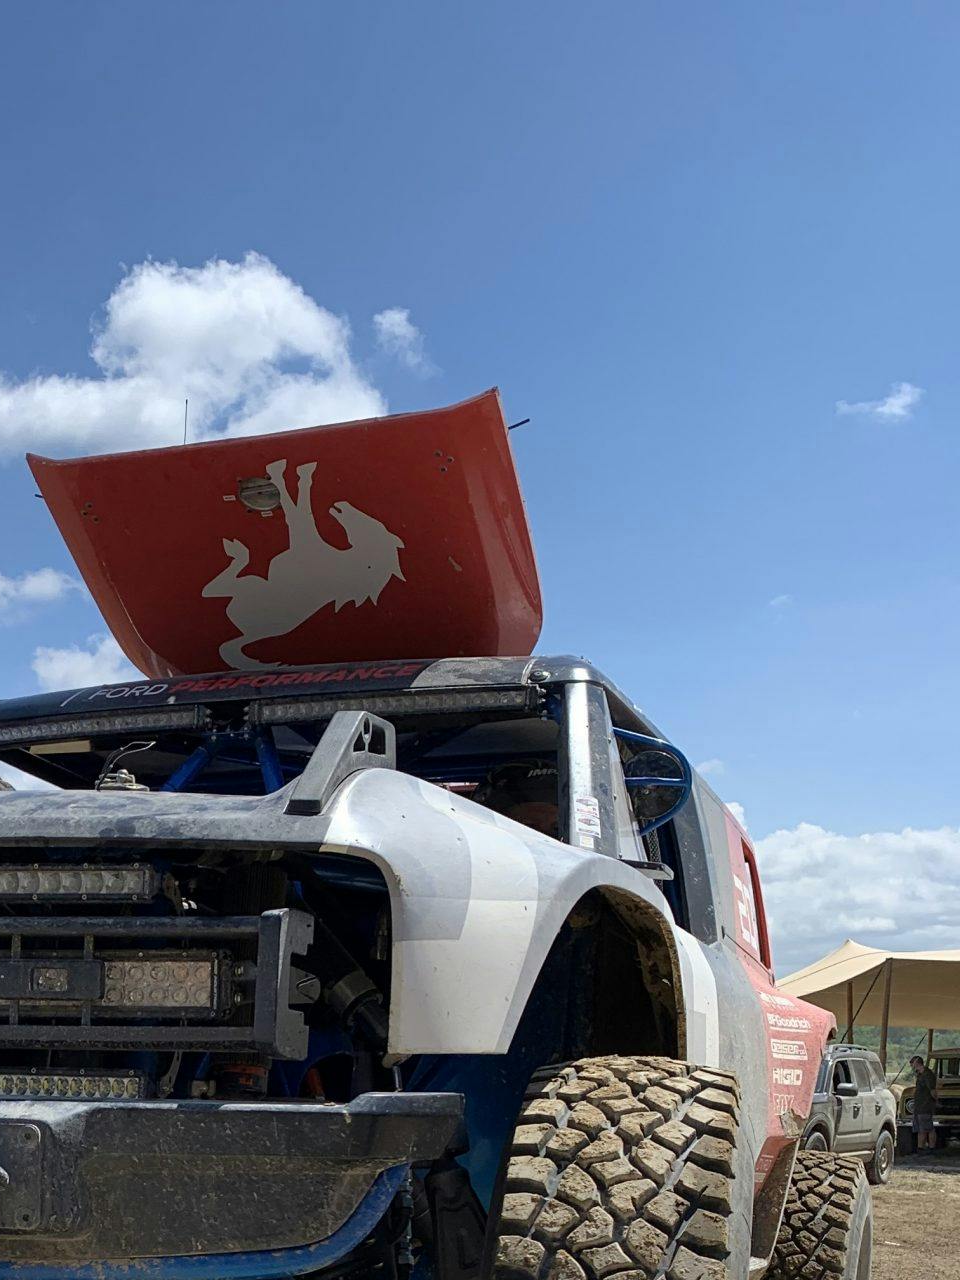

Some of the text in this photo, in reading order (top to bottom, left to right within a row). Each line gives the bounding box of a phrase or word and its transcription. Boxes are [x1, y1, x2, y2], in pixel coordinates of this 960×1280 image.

[89, 663, 423, 700] FORD PERFORMANCE
[772, 1068, 803, 1086] RIGID
